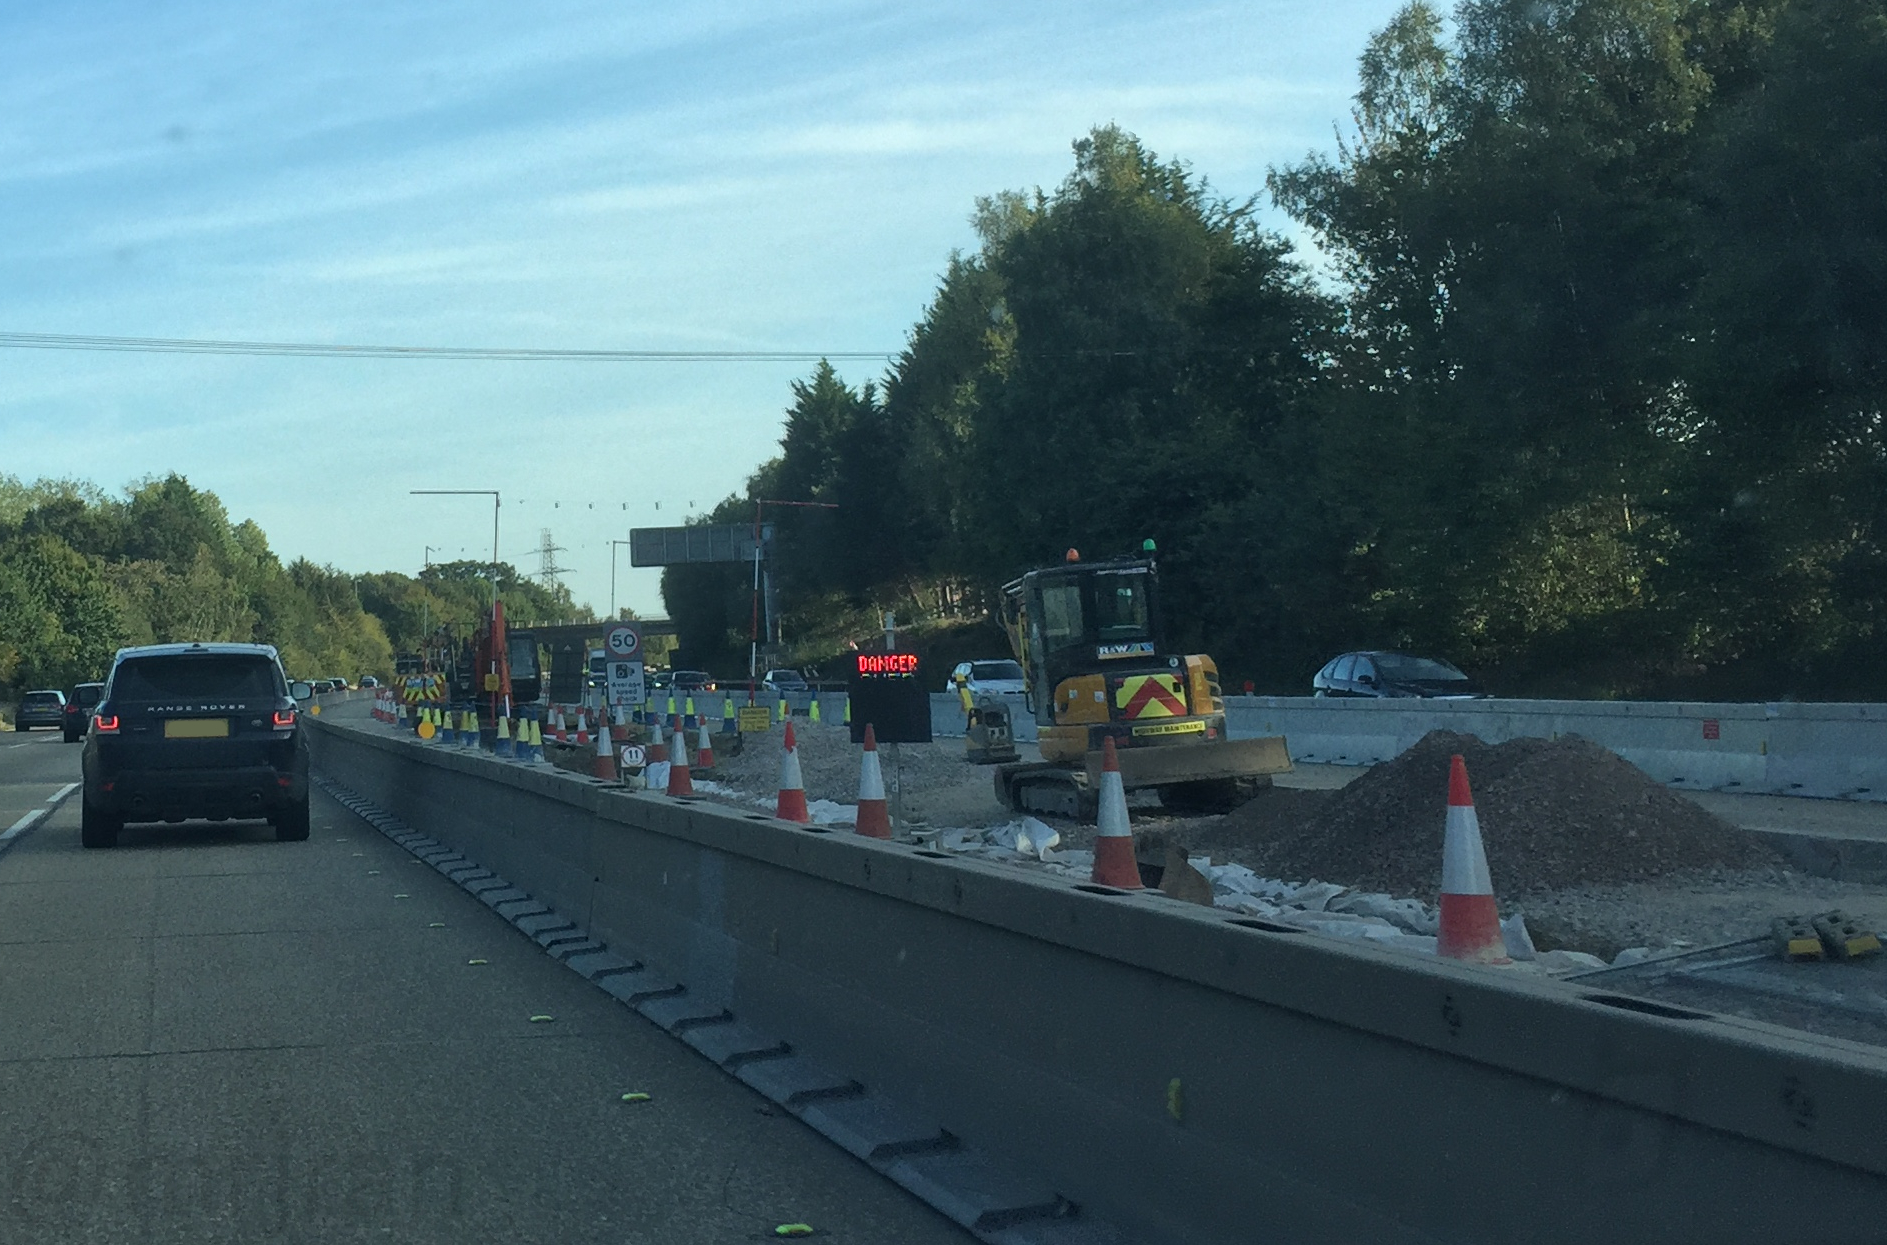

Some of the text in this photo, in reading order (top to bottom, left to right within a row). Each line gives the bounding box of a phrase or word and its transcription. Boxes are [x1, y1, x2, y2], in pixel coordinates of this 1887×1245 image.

[611, 633, 636, 648] 50
[858, 655, 918, 672] DANGER
[628, 749, 639, 759] 11
